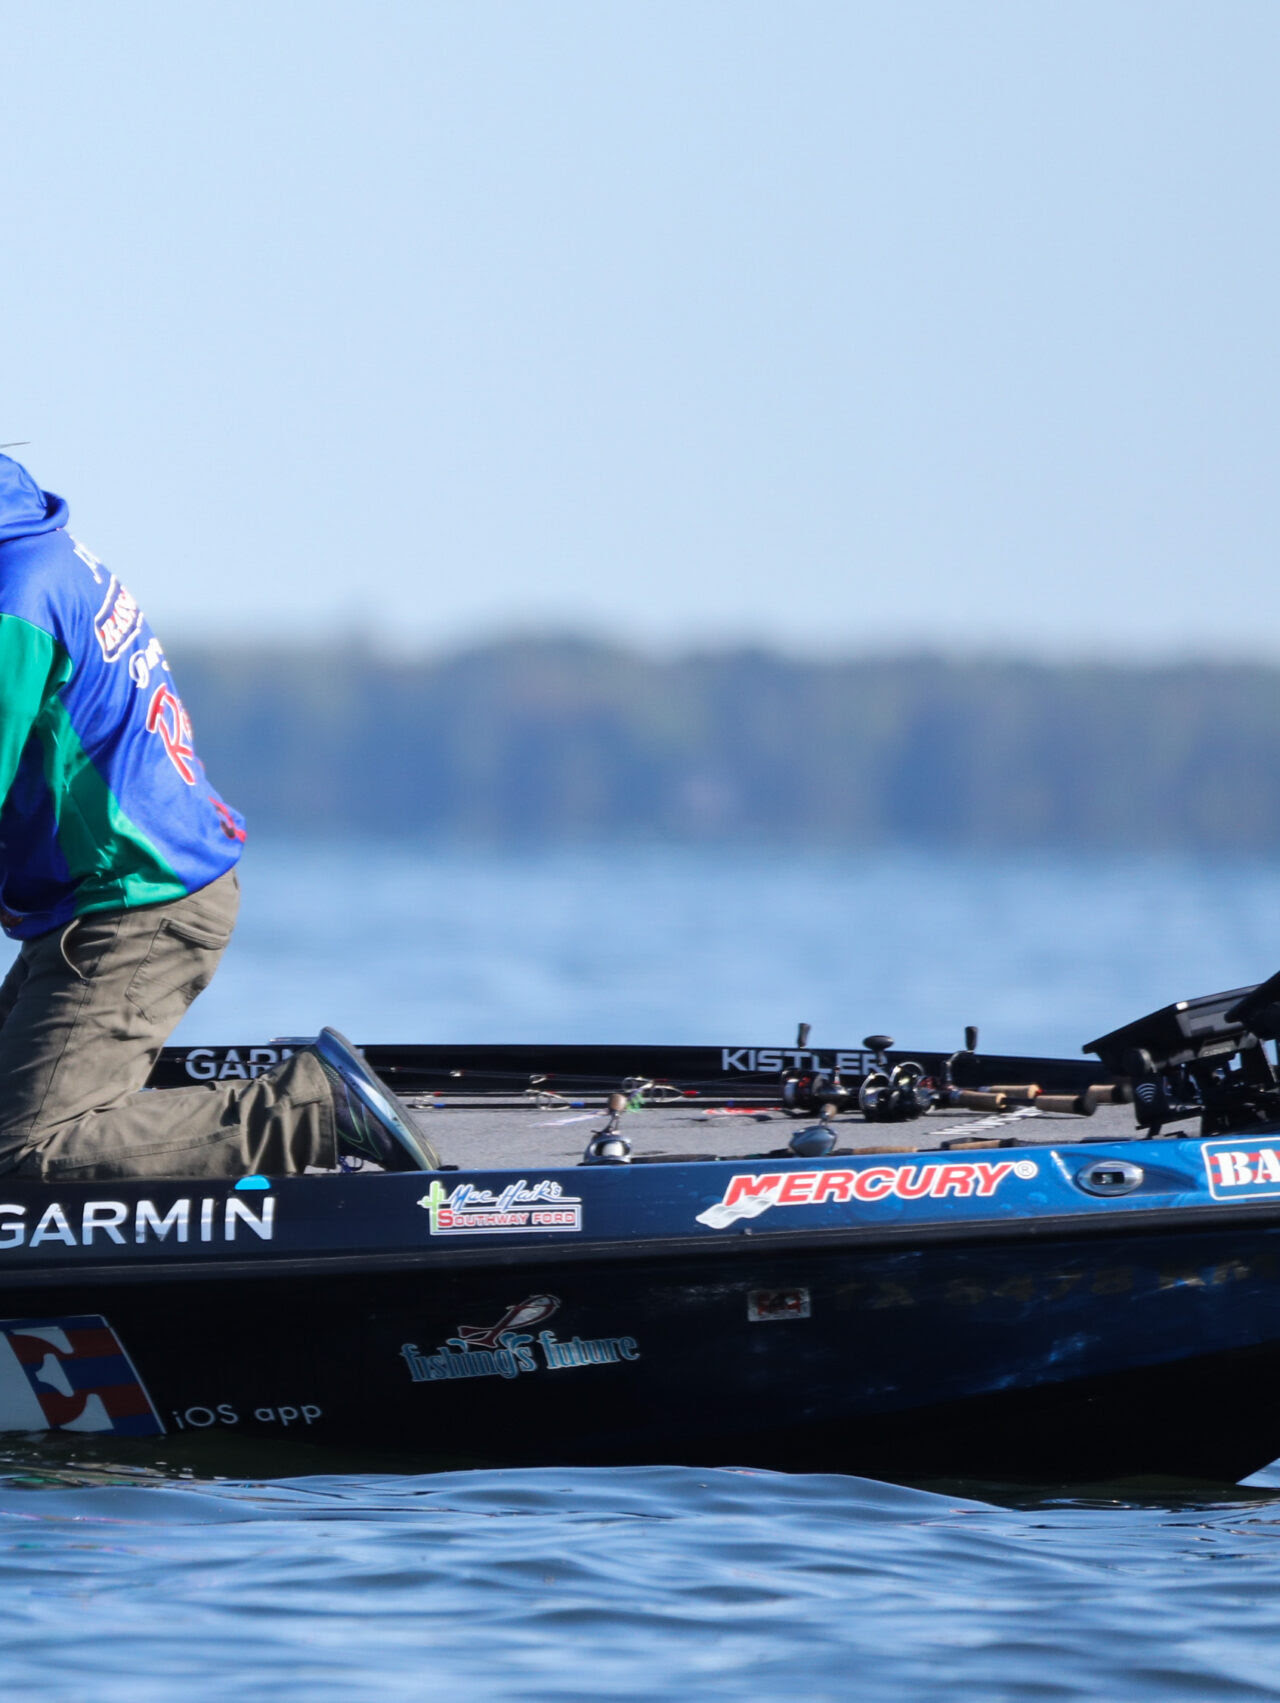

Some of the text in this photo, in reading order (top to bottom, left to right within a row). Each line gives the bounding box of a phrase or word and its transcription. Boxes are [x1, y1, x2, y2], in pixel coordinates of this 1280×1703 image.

[185, 1048, 297, 1080] GAR
[722, 1049, 888, 1076] KISTLER
[450, 1184, 493, 1212] Mac
[437, 1209, 576, 1228] SOUTHWAY FORD
[400, 1330, 641, 1382] fishing's future
[172, 1404, 322, 1429] iOS app
